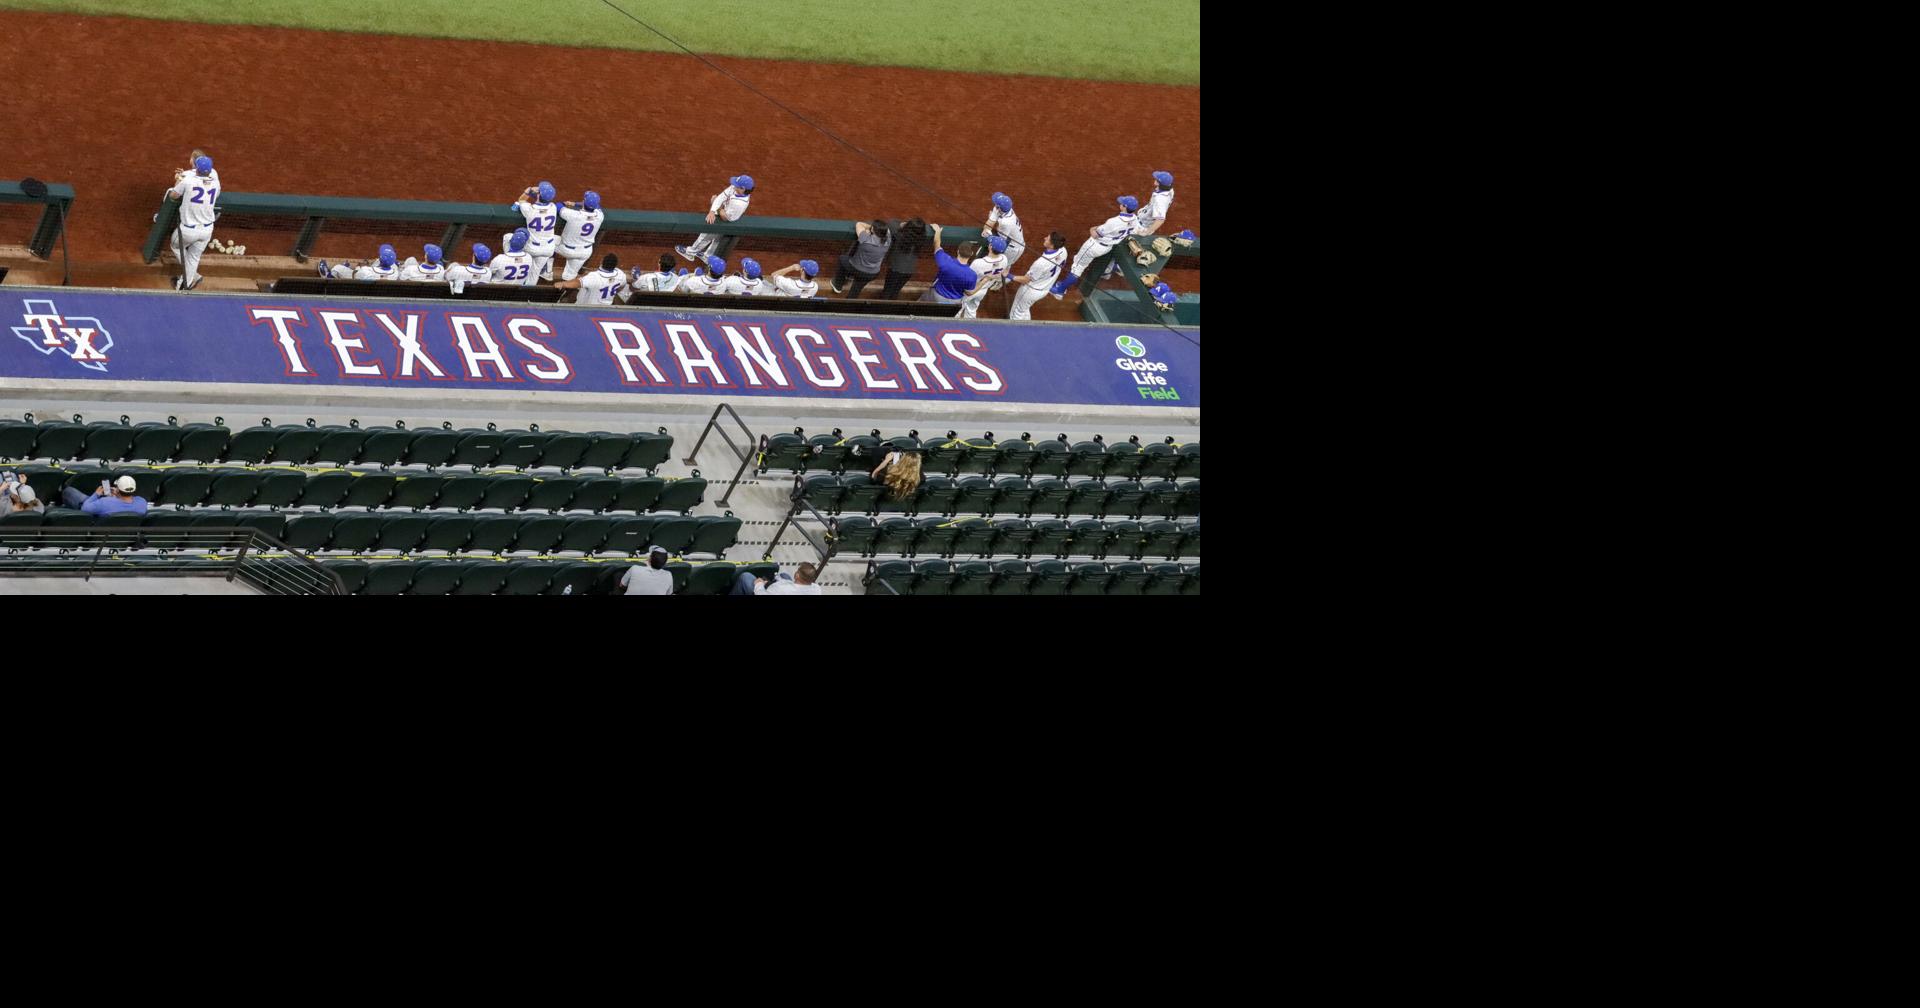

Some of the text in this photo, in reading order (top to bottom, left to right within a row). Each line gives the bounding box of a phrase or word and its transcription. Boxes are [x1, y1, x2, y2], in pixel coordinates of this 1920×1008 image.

[190, 186, 216, 205] 21
[528, 215, 556, 232] 42
[580, 222, 595, 237] 9
[503, 264, 530, 281] 23
[22, 313, 109, 361] TX
[247, 306, 1006, 395] TEXAS RANGERS
[1115, 357, 1169, 372] Globe
[1131, 371, 1168, 386] Life
[1137, 386, 1181, 400] Field
